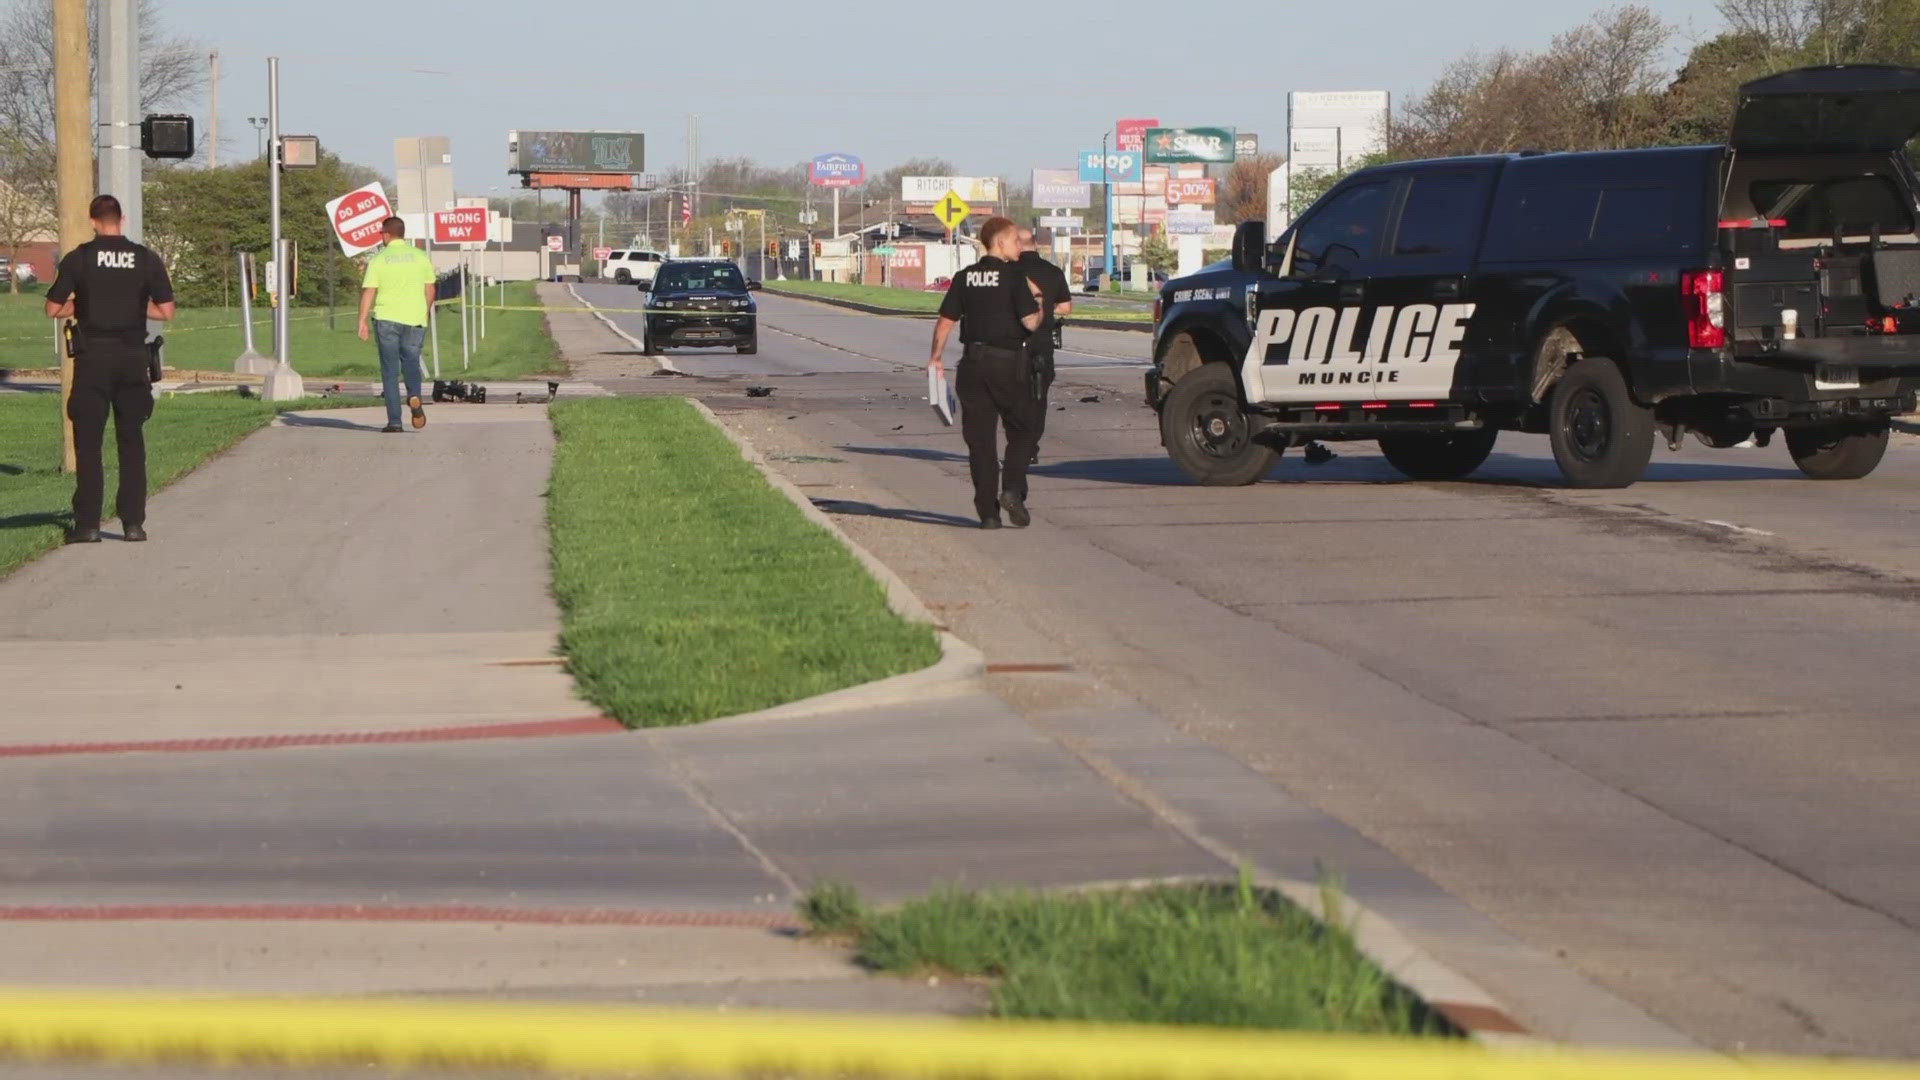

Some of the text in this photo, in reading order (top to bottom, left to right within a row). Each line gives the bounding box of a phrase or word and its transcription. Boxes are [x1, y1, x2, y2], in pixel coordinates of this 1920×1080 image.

[1126, 144, 1143, 152] KIN
[1173, 135, 1223, 150] STAR
[816, 161, 858, 171] FAIRFIELD
[917, 179, 954, 191] RITCHIE
[1168, 182, 1211, 204] 5.00%
[338, 196, 378, 219] DO NOT
[439, 213, 481, 225] WRONG
[351, 222, 383, 242] ENTER
[448, 227, 473, 238] WAY
[97, 251, 136, 269] POLICE
[890, 258, 921, 268] GUYS
[966, 271, 1000, 287] POLICE
[1257, 303, 1477, 366] POLICE
[1298, 370, 1400, 385] MUNCIE
